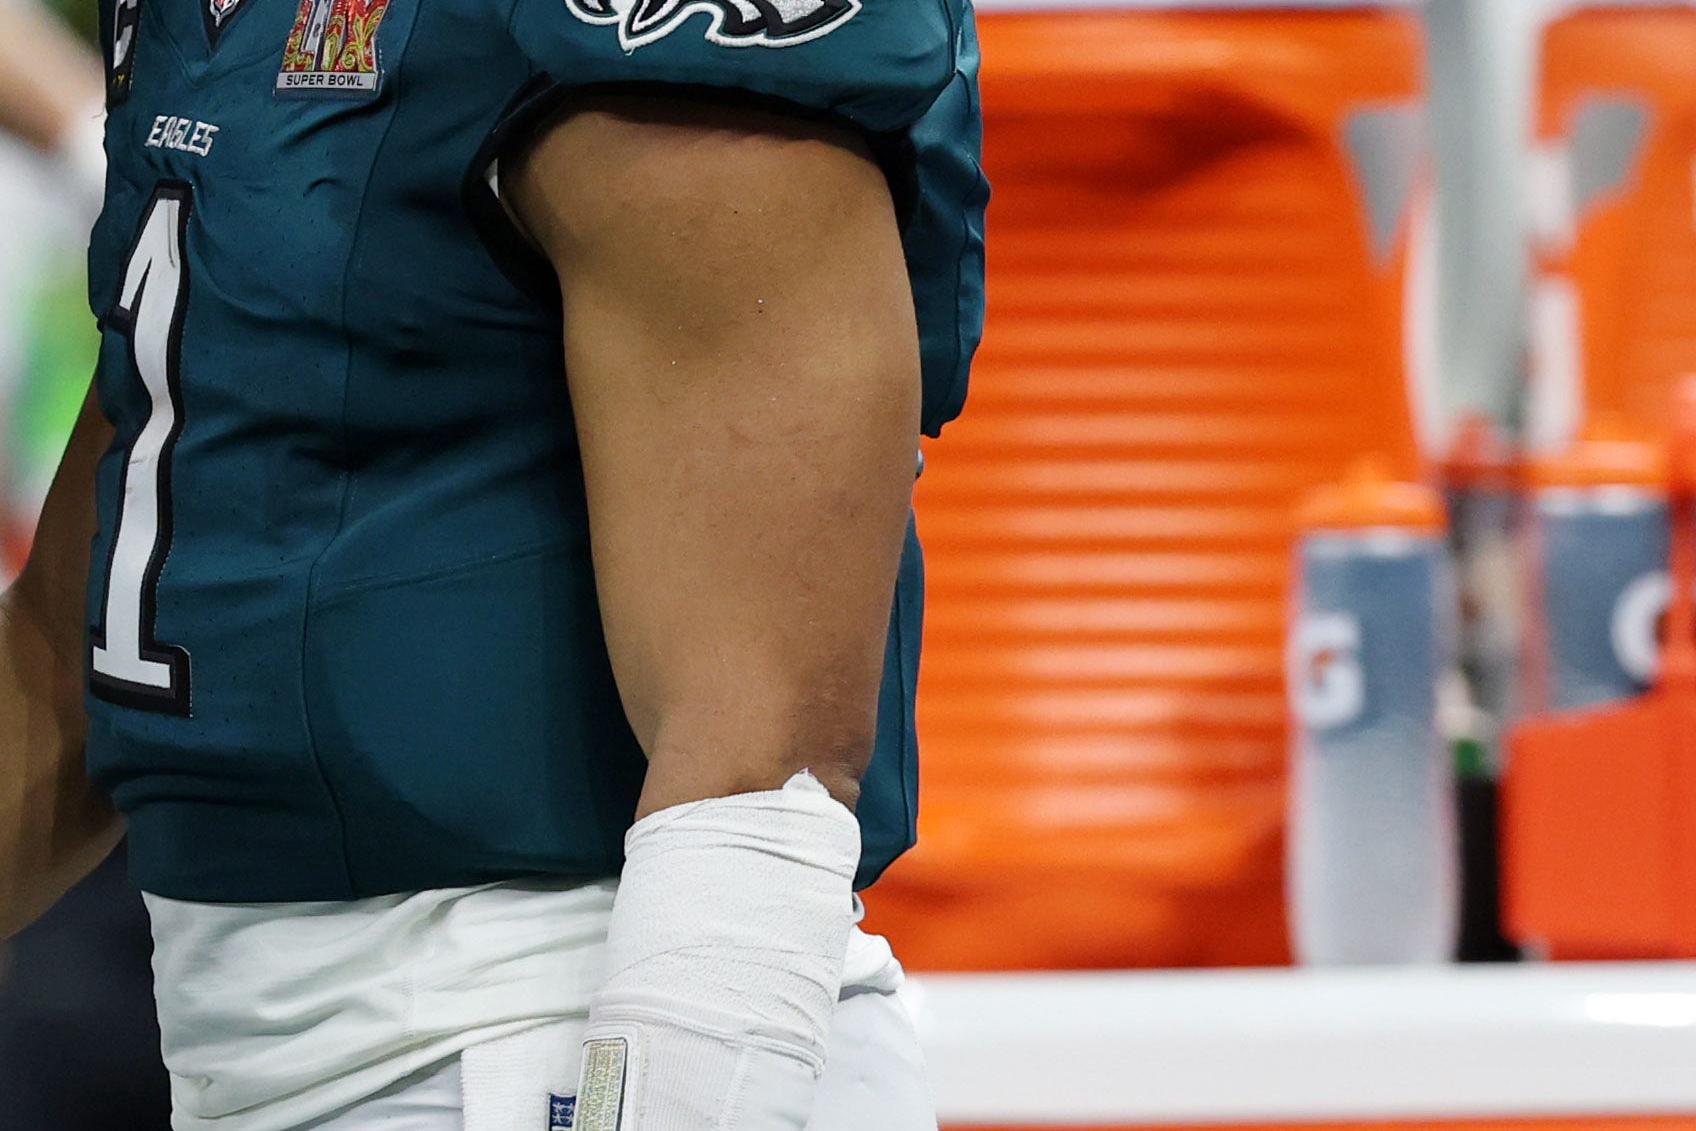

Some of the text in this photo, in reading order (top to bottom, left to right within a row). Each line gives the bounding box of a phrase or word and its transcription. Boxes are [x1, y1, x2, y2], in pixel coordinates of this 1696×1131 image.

[285, 73, 364, 87] SUPER BOWL
[144, 114, 220, 157] EAGLES
[91, 186, 191, 708] 1
